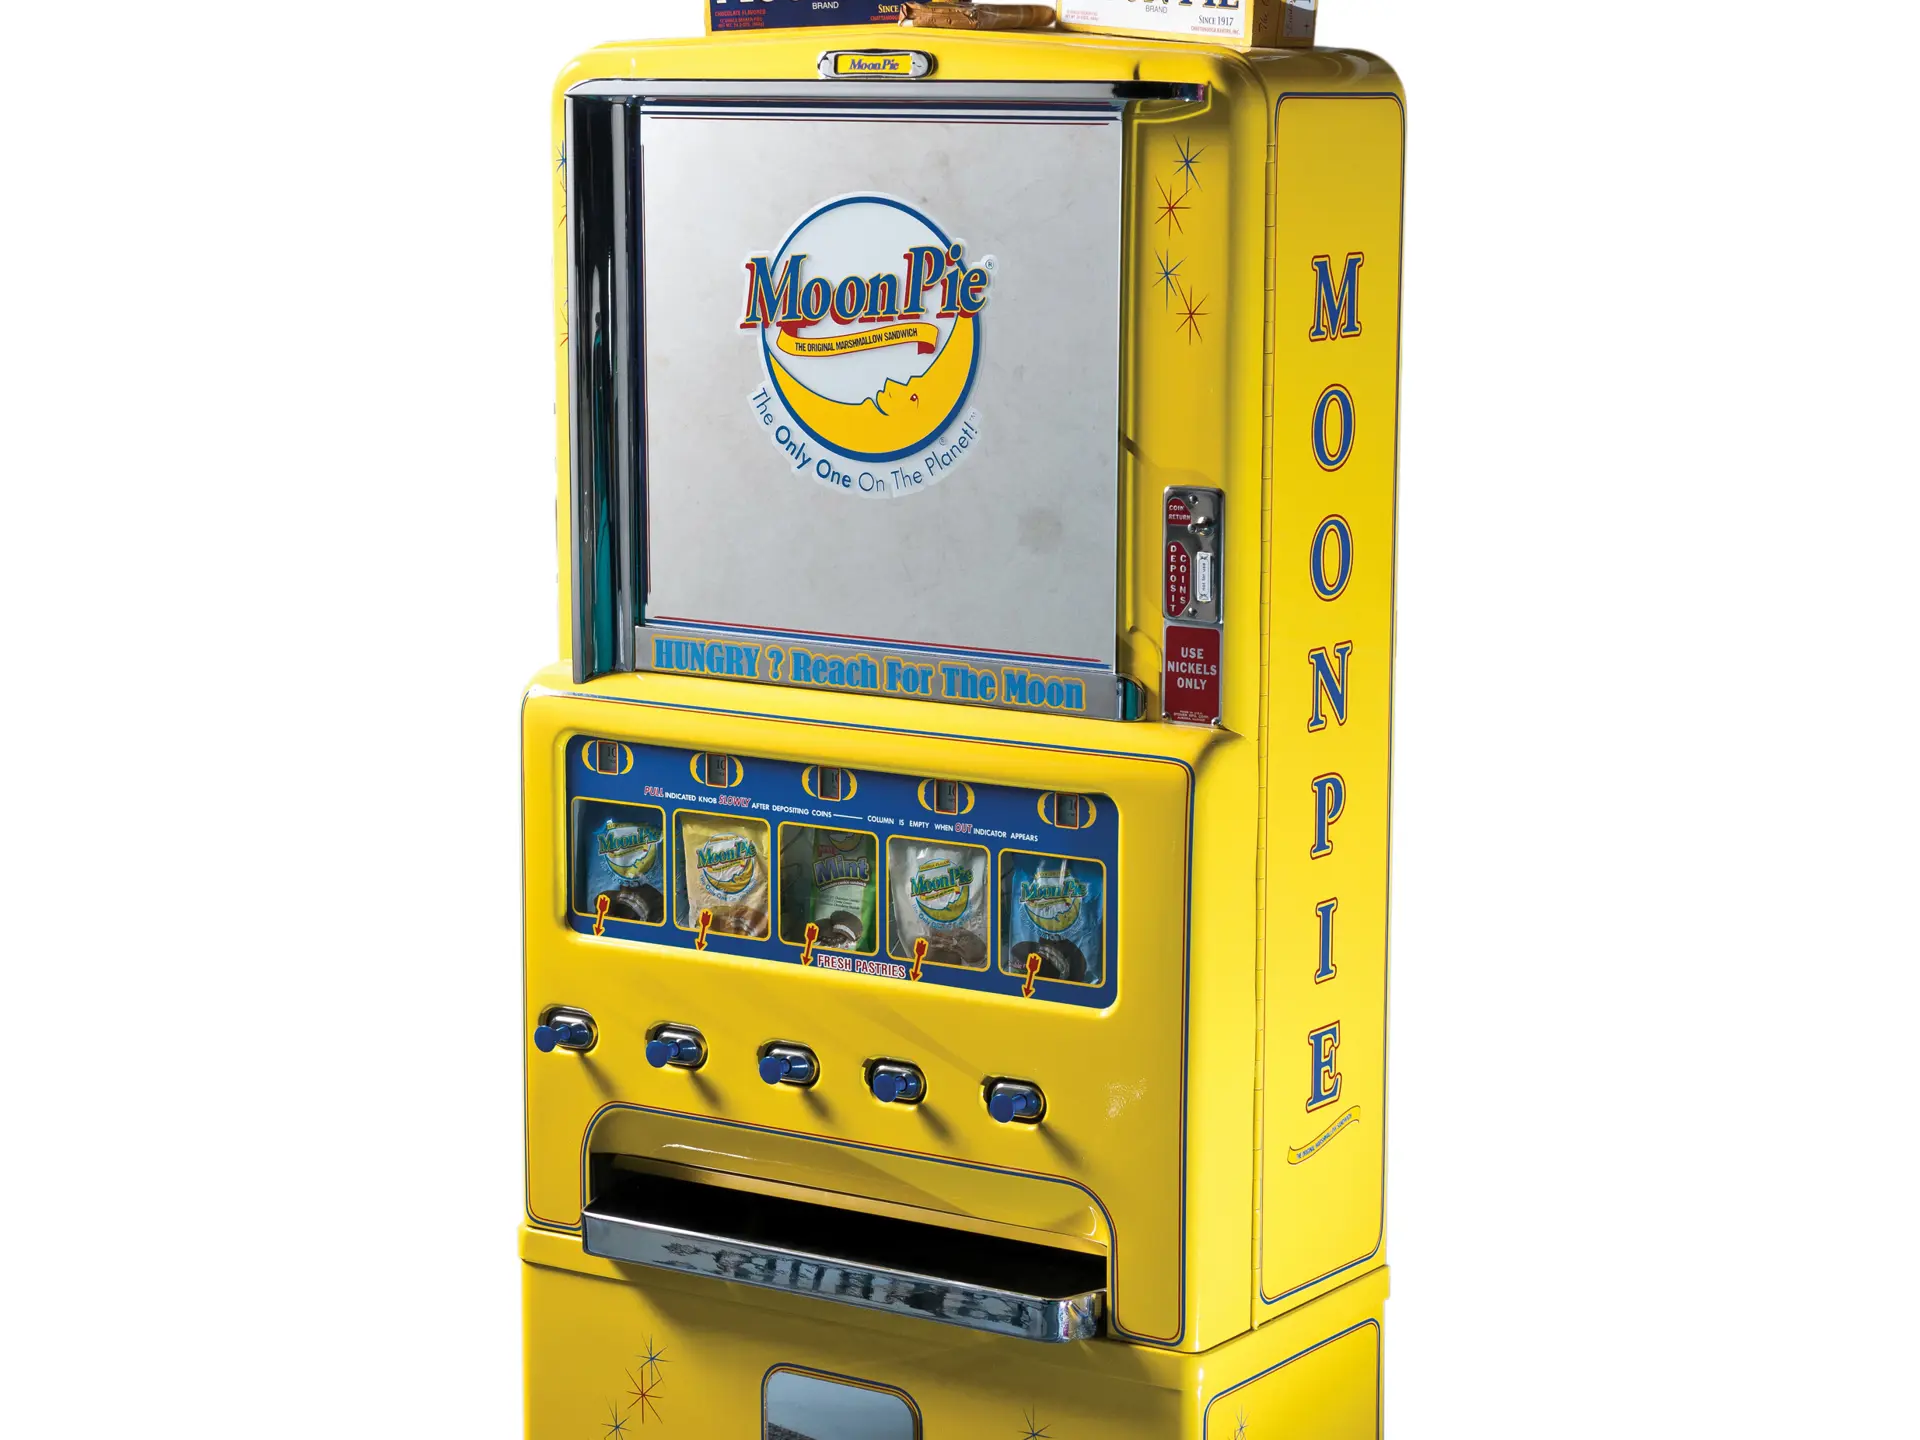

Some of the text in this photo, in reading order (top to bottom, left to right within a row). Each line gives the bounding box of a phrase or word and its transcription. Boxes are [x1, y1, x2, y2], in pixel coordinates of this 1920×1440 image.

[812, 1, 839, 10] BRAND
[878, 3, 899, 13] SINCE
[1145, 4, 1168, 14] BRAND
[1198, 15, 1234, 27] SINCE 1917
[795, 327, 918, 352] THE ORIGINAL MARSHMALLOW SANDWICH
[752, 387, 774, 426] The
[775, 424, 812, 470] Only
[815, 458, 852, 489] One
[858, 472, 885, 492] On
[891, 467, 923, 491] The
[1180, 647, 1204, 660] USE
[652, 636, 762, 679] HUNGRY
[790, 648, 880, 690] Reach
[883, 656, 935, 696] For
[939, 661, 998, 702] The
[1001, 666, 1086, 711] Moon
[1167, 660, 1217, 676] NICKELS
[1176, 676, 1207, 690] ONLY
[643, 785, 832, 818] PULL INDICATED KNOB SLOWLY AFTER DEPOSITING COINS
[867, 815, 1039, 842] COLUMN IS EMPTY WHEN OUT INDICATOR APPEARS
[814, 855, 870, 885] Mint
[817, 954, 905, 978] FRESH PASTRIES
